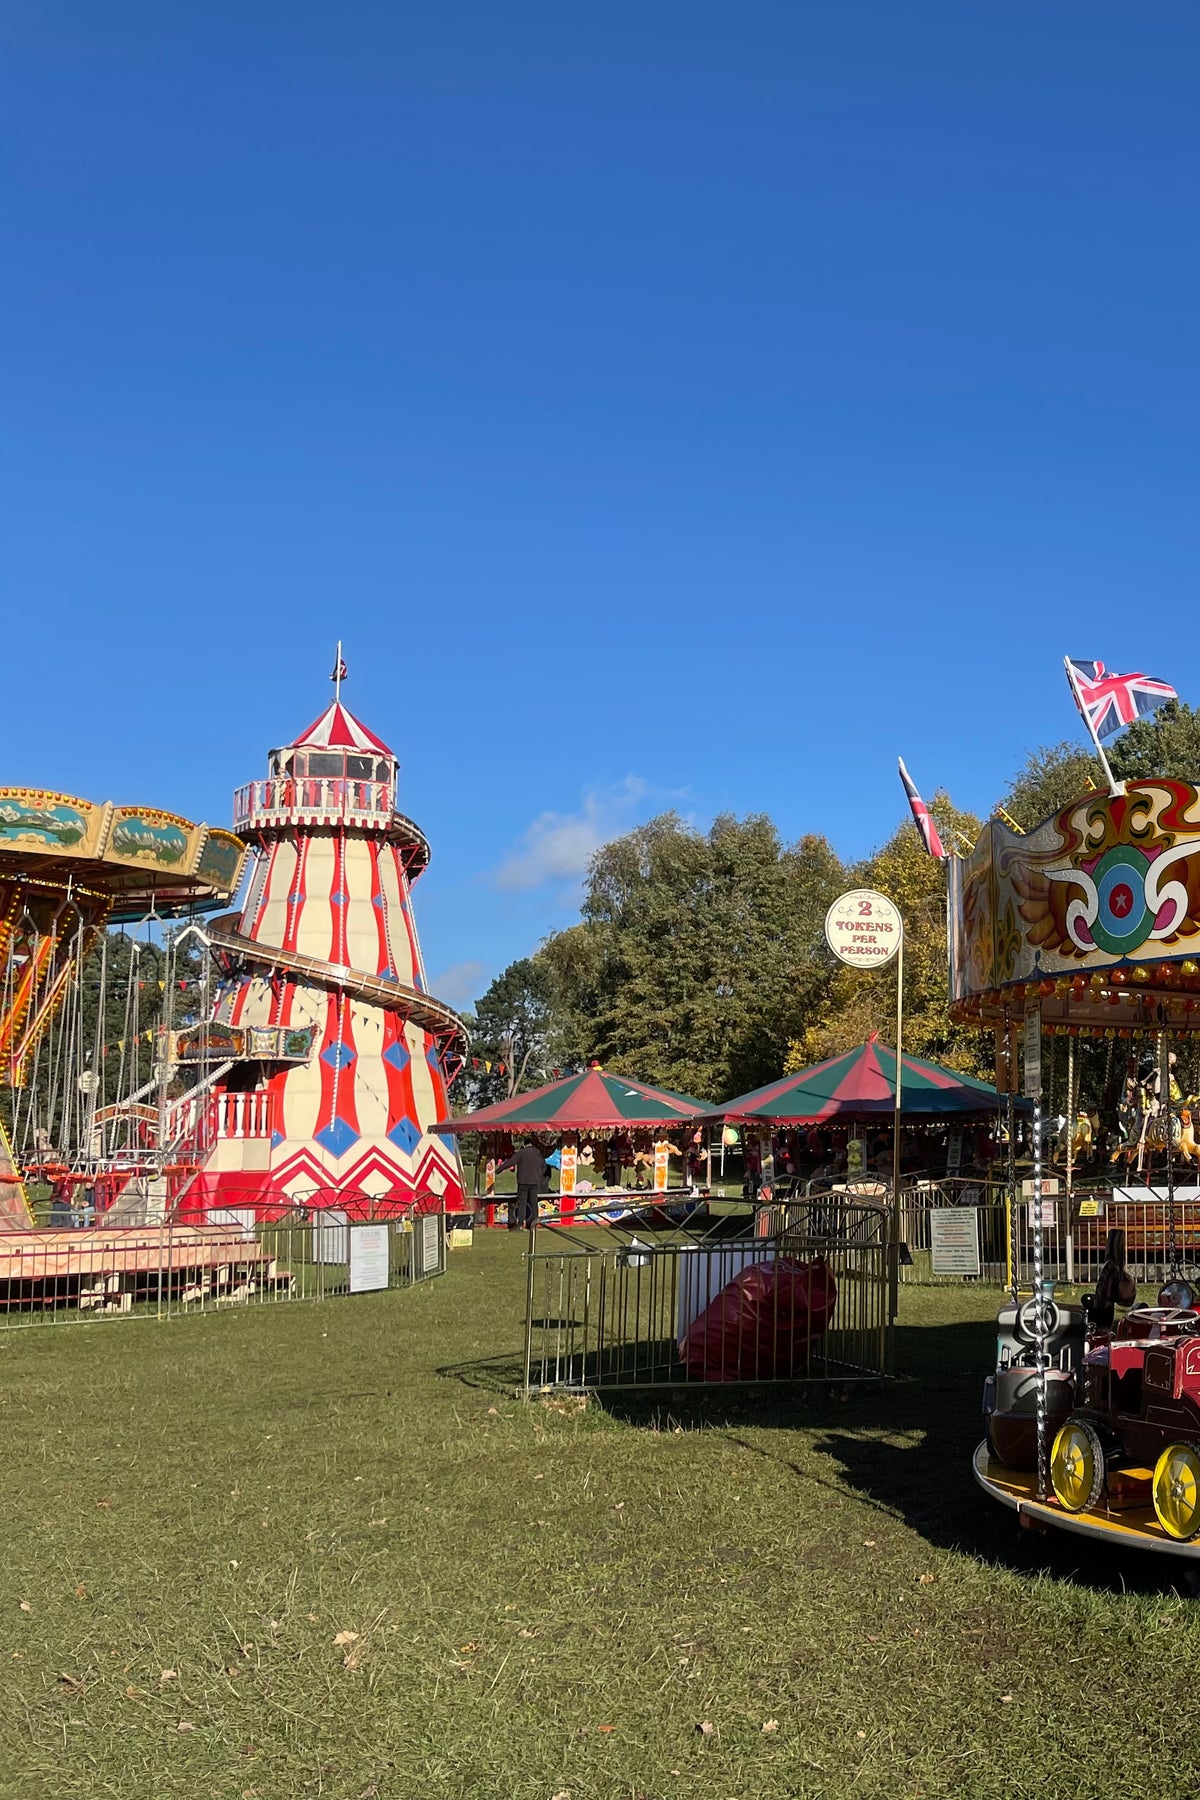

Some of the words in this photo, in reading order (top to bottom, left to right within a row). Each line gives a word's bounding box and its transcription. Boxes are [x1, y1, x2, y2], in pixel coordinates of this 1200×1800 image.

[858, 900, 873, 917] 2
[836, 921, 893, 933] TOKENS
[852, 935, 877, 944] PER
[840, 946, 889, 956] PERSON
